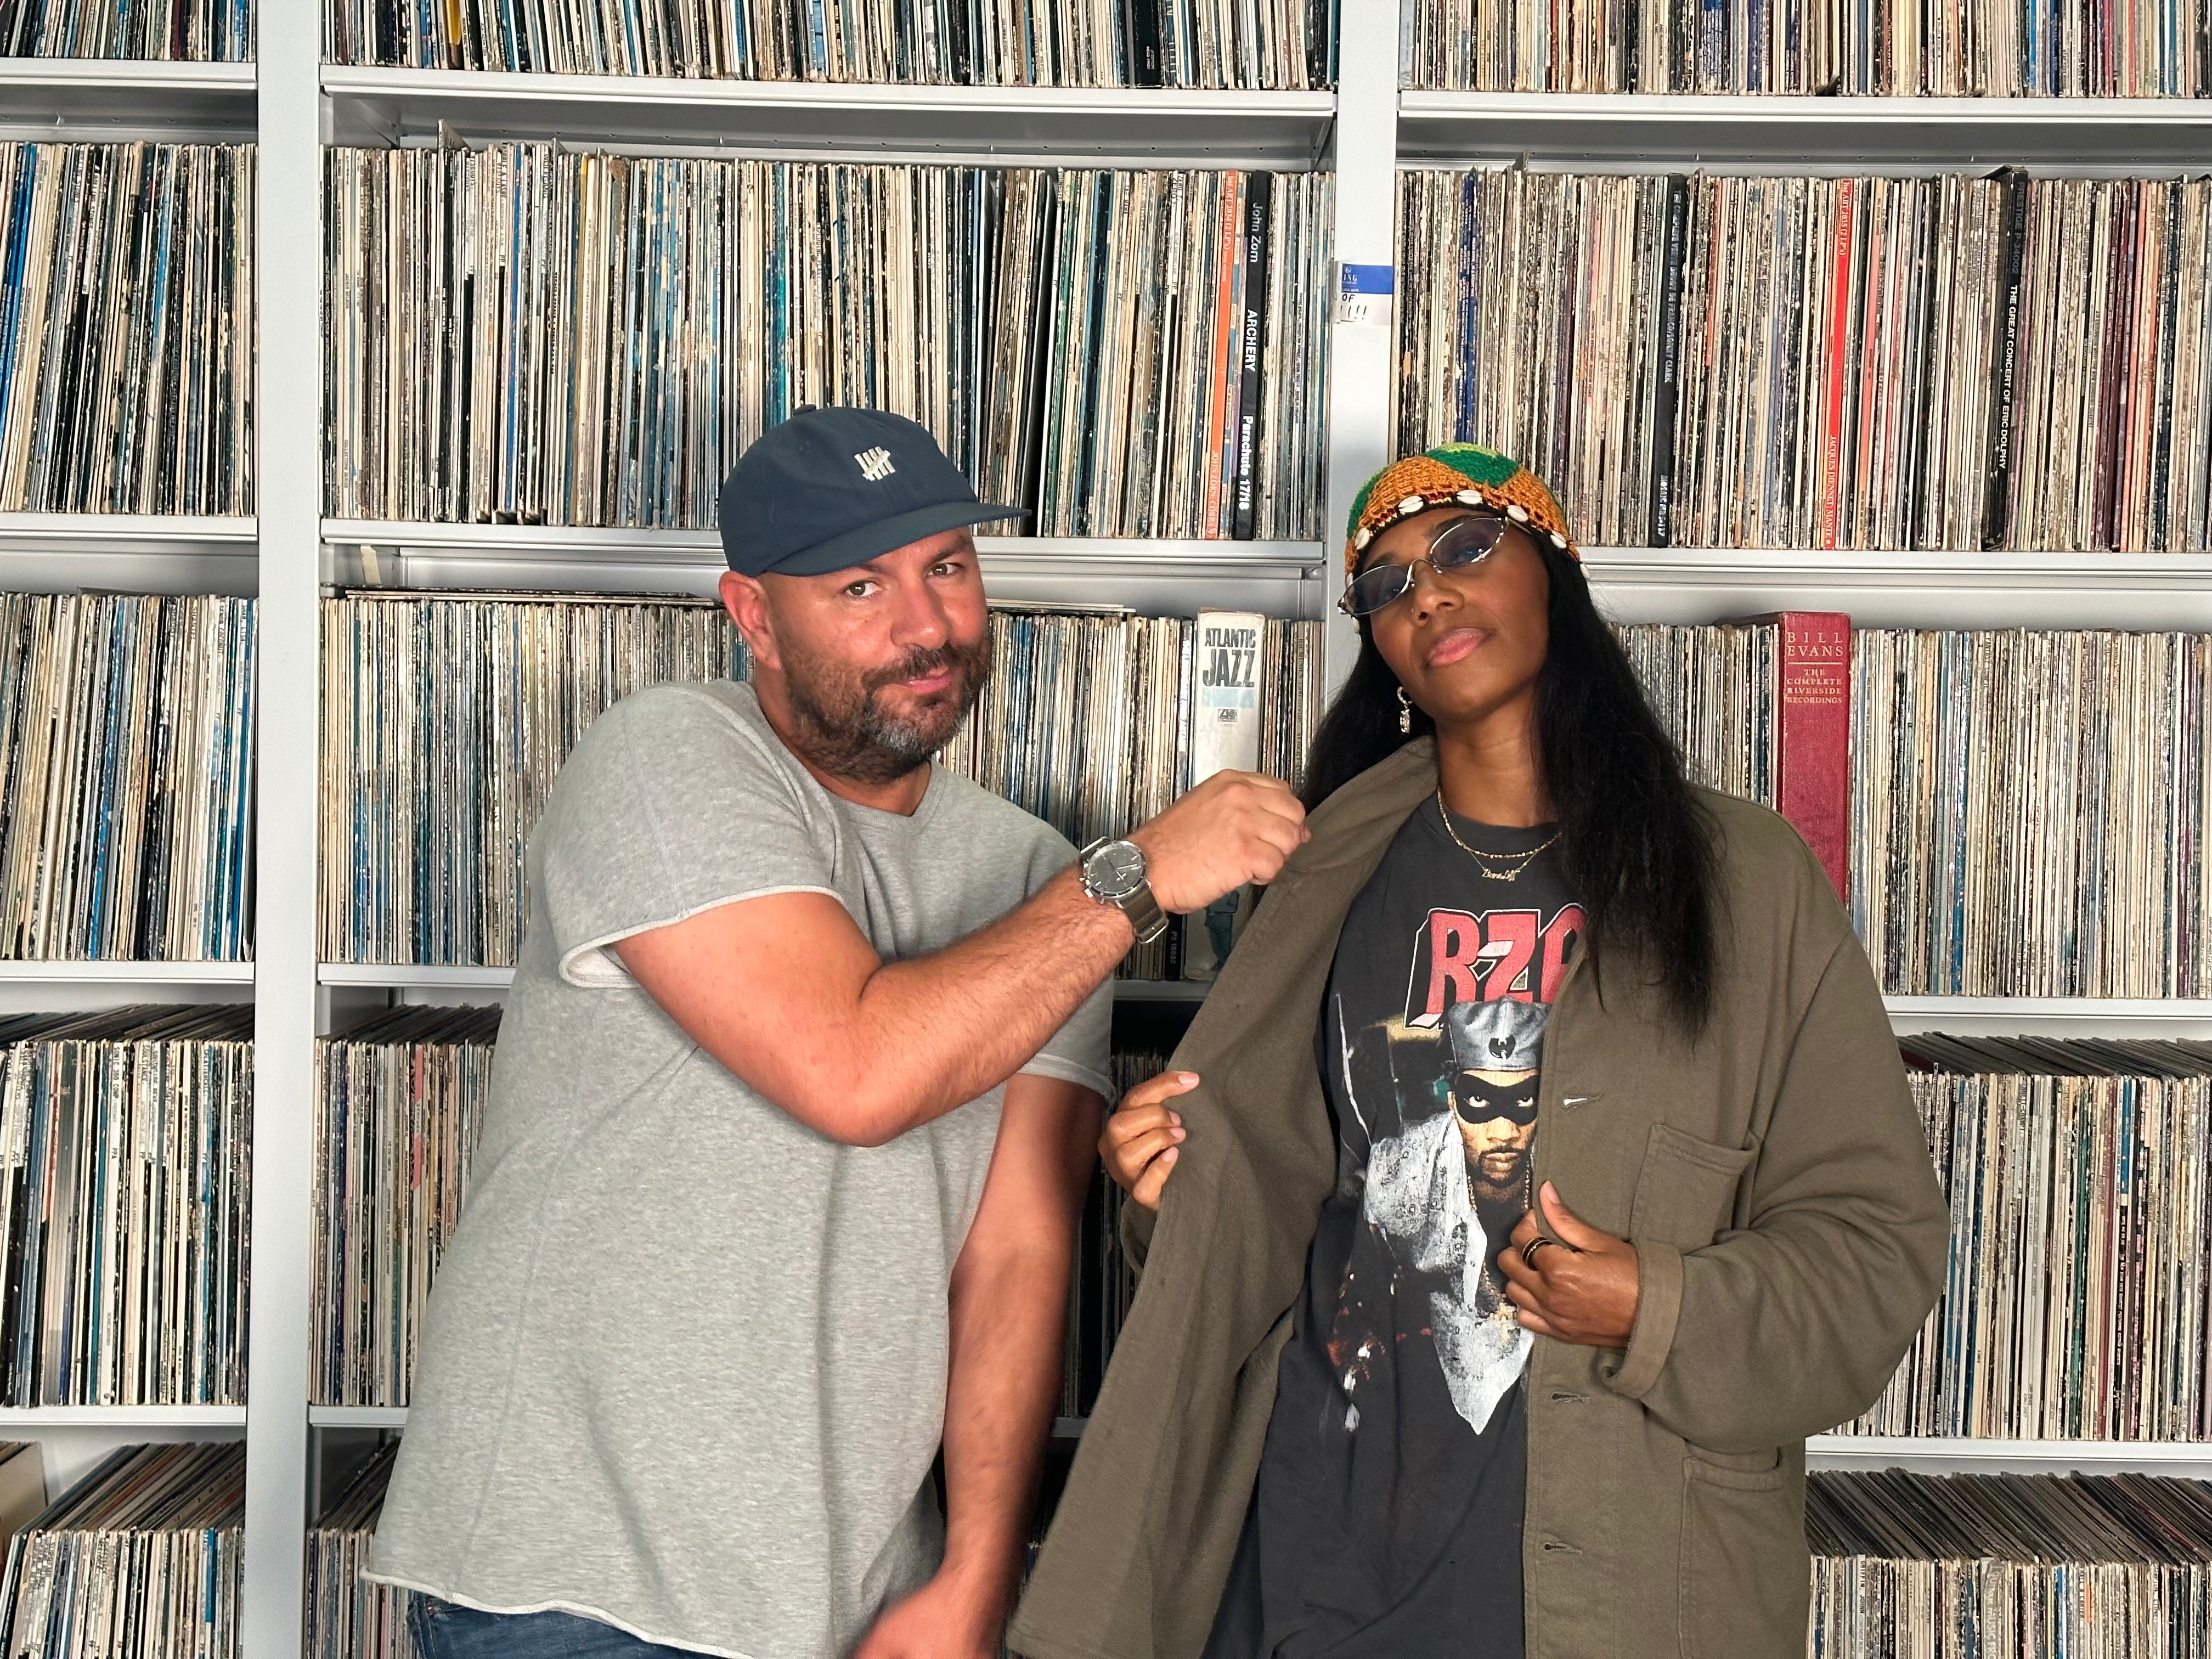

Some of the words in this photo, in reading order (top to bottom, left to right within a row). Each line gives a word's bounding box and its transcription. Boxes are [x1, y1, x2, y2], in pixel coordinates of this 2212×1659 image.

[1226, 187, 1234, 204] ART
[1841, 193, 1849, 210] ART
[2014, 181, 2025, 229] PRESTIGE
[1251, 202, 1263, 232] John
[1671, 205, 1680, 242] COMPLETE
[1841, 211, 1849, 228] 2035
[2011, 232, 2022, 274] P-34002
[1668, 292, 1676, 302] DE
[2009, 285, 2018, 304] THE
[2007, 306, 2017, 338] GREAT
[1244, 308, 1258, 372] ARCHERY
[1664, 359, 1673, 383] CLARK
[2004, 340, 2014, 388] CONCERT
[2002, 390, 2011, 403] OF
[2001, 405, 2010, 428] ERIC
[1240, 415, 1254, 476] Parachute
[1827, 435, 1837, 470] JACQUES
[1999, 429, 2008, 470] DOLPHY
[1211, 451, 1220, 472] JOHN
[1239, 479, 1250, 510] 17/18
[1660, 475, 1668, 503] MOSAIC
[1204, 628, 1256, 648] ATLANTIC
[1787, 632, 1843, 643] BILL
[1787, 645, 1844, 657] EVANS
[1203, 648, 1256, 688] JAZZ
[1987, 1607, 1997, 1640] MUSIC
